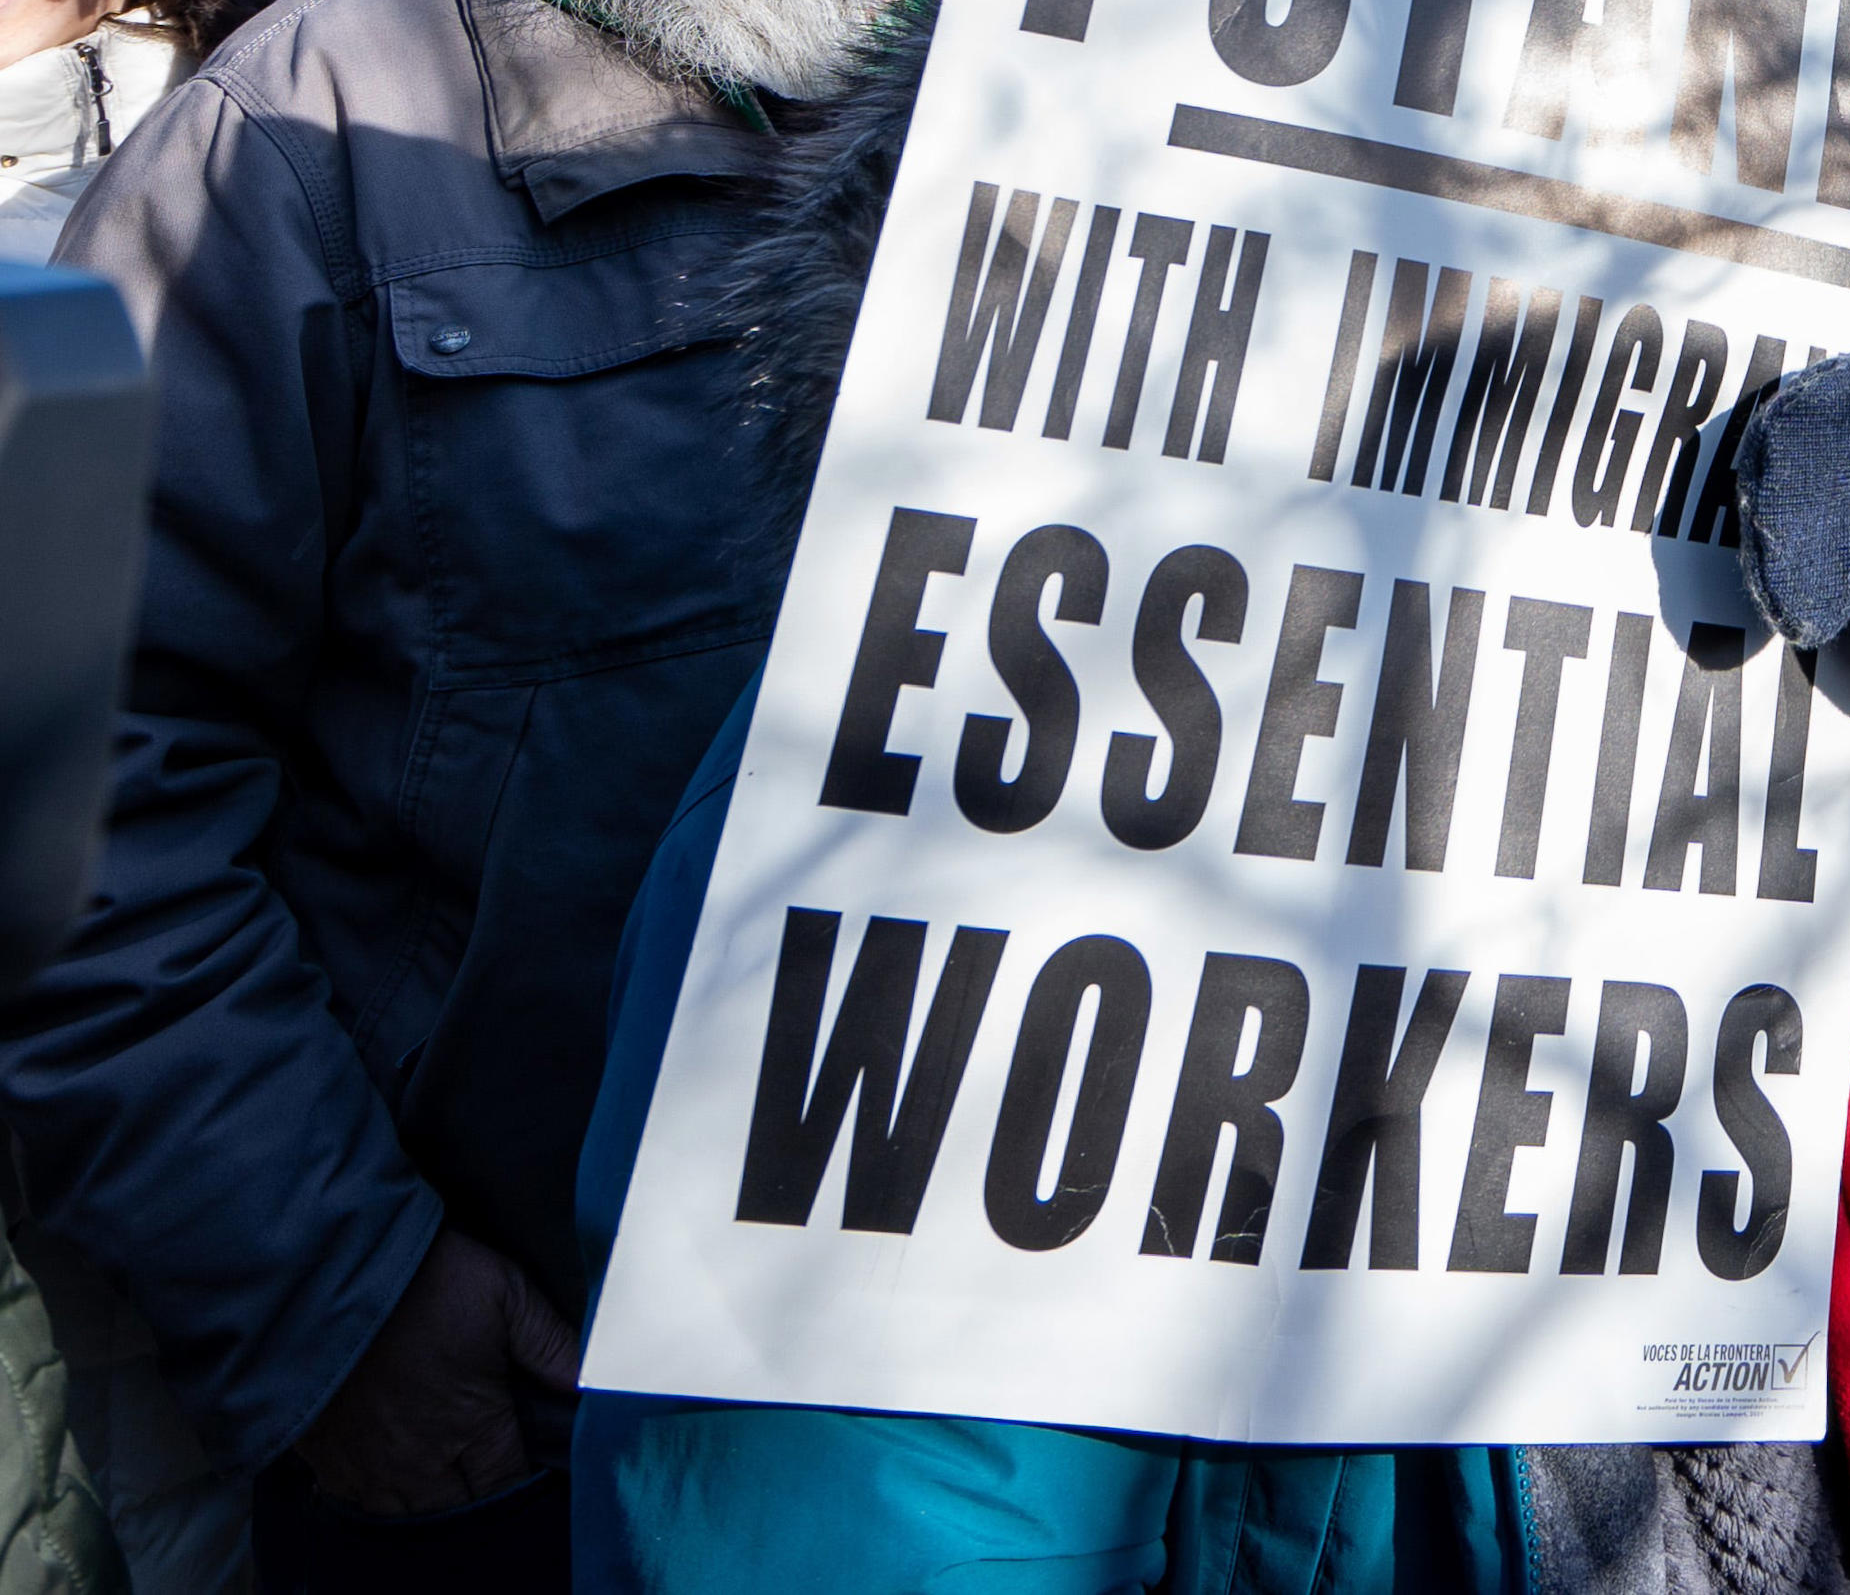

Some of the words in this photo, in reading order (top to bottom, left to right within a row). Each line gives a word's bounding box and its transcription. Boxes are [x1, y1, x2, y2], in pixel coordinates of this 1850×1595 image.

[926, 181, 1271, 465] WITH
[1308, 249, 1850, 549] IMMIGRA
[818, 506, 1820, 903] ESSENTIAL
[733, 905, 1803, 1282] WORKERS
[1643, 1344, 1678, 1361] VOCES
[1680, 1344, 1695, 1361] DE
[1697, 1344, 1710, 1361] LA
[1713, 1344, 1770, 1361] FRONTERA
[1672, 1362, 1770, 1391] ACTION
